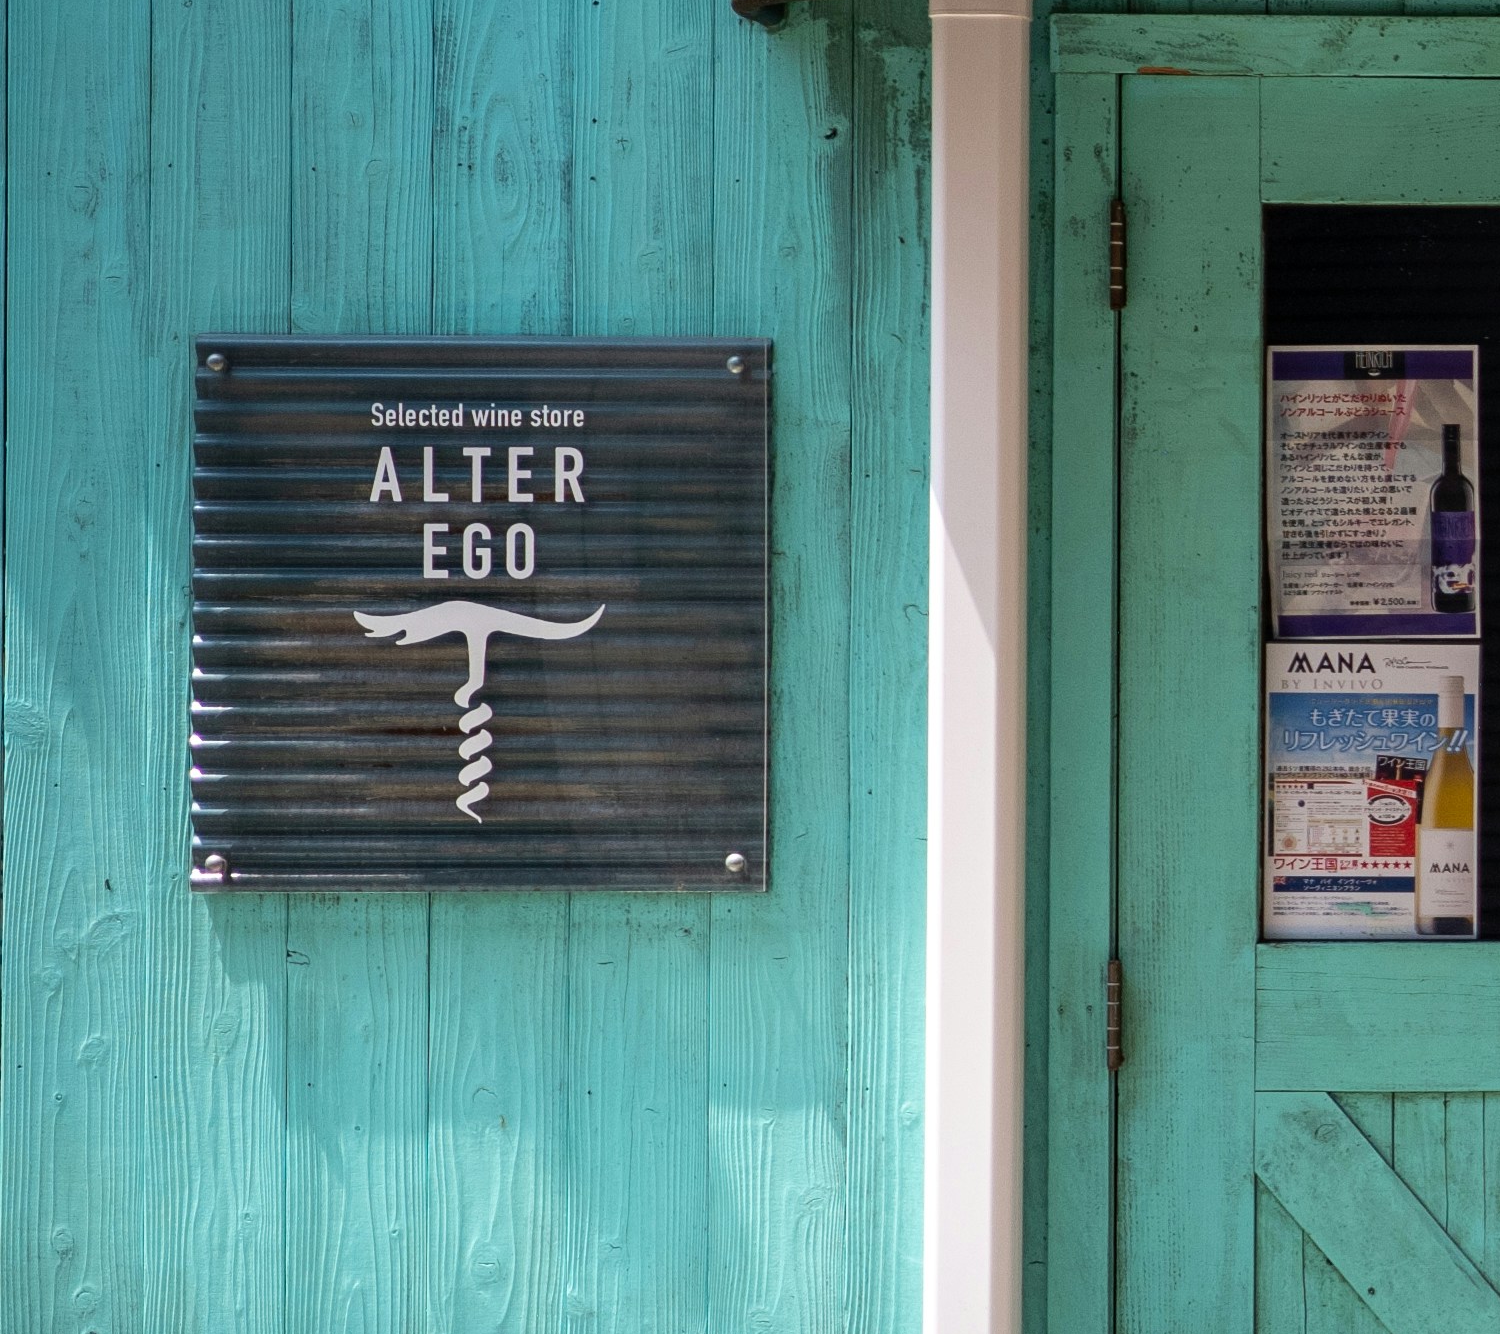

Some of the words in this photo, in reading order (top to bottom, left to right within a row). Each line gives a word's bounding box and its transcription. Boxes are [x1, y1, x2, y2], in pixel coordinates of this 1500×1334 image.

[1279, 393, 1407, 404] ハインリッヒがこだわりぬいた
[370, 403, 464, 428] Selected
[471, 403, 523, 428] wine
[530, 405, 585, 428] store
[1279, 406, 1406, 418] ノンアルコールぶどうジュース
[369, 445, 585, 503] ALTER
[422, 523, 535, 579] EGO
[1287, 652, 1377, 674] MANA
[1280, 679, 1302, 690] BY
[1309, 708, 1436, 728] もぎたて果実の
[1273, 858, 1338, 871] ワイン王国
[1429, 862, 1471, 873] MANA
